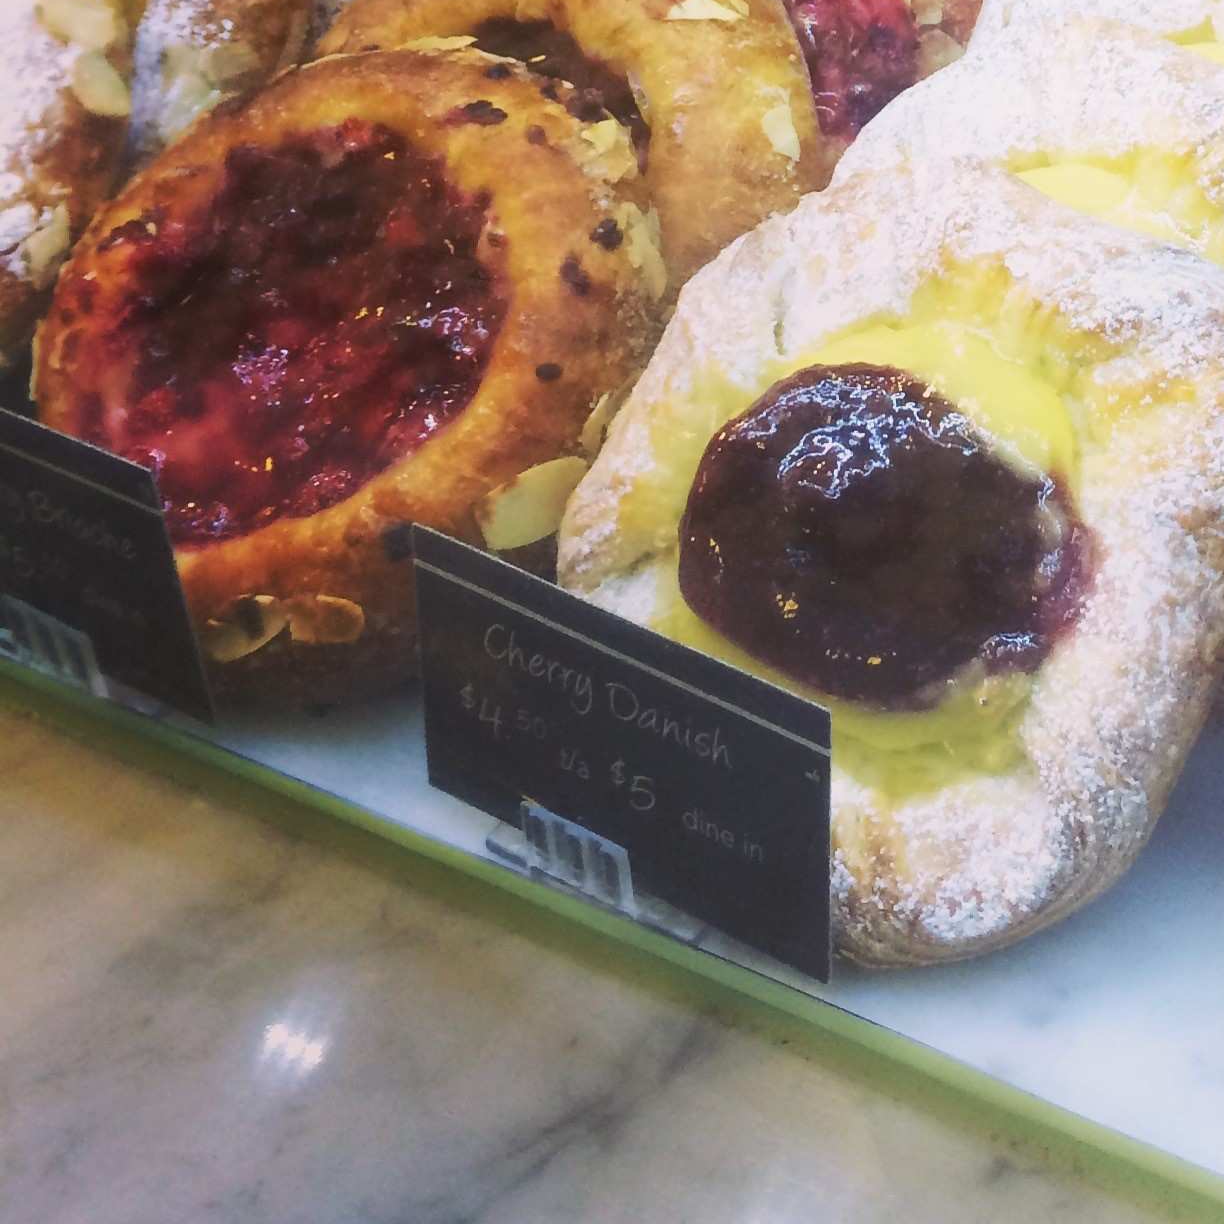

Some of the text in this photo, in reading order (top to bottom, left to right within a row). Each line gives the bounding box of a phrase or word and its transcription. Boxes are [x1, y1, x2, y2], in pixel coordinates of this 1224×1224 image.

[483, 624, 733, 768] Cherry Danish
[610, 758, 656, 811] $5
[681, 808, 735, 849] dine
[744, 835, 764, 862] in
